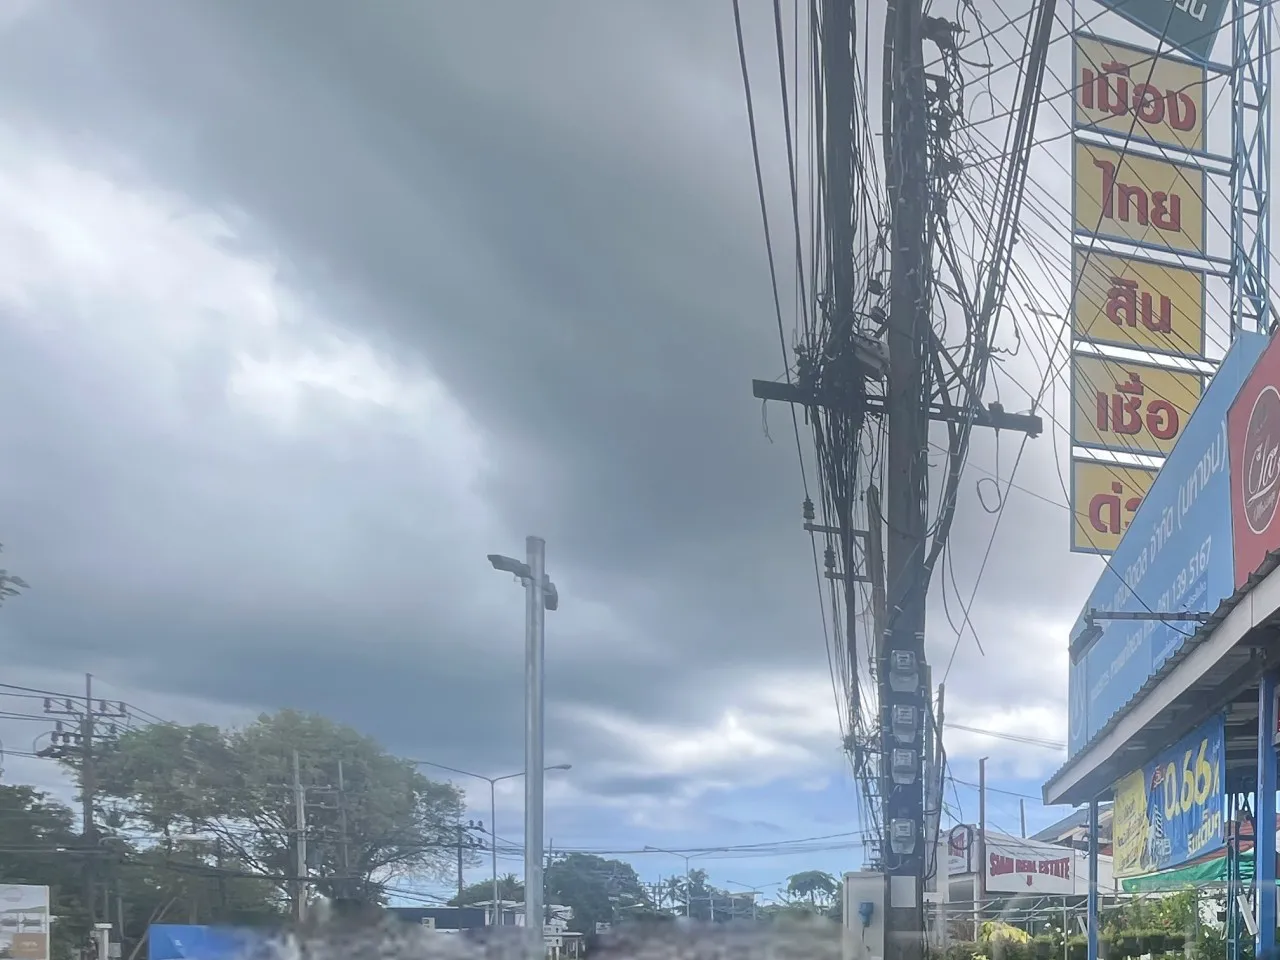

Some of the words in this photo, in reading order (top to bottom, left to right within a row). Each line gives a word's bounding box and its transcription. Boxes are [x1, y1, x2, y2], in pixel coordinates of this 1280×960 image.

[1082, 60, 1197, 132] เมือง
[1093, 158, 1181, 233] ไทย
[1105, 276, 1172, 334] สิน
